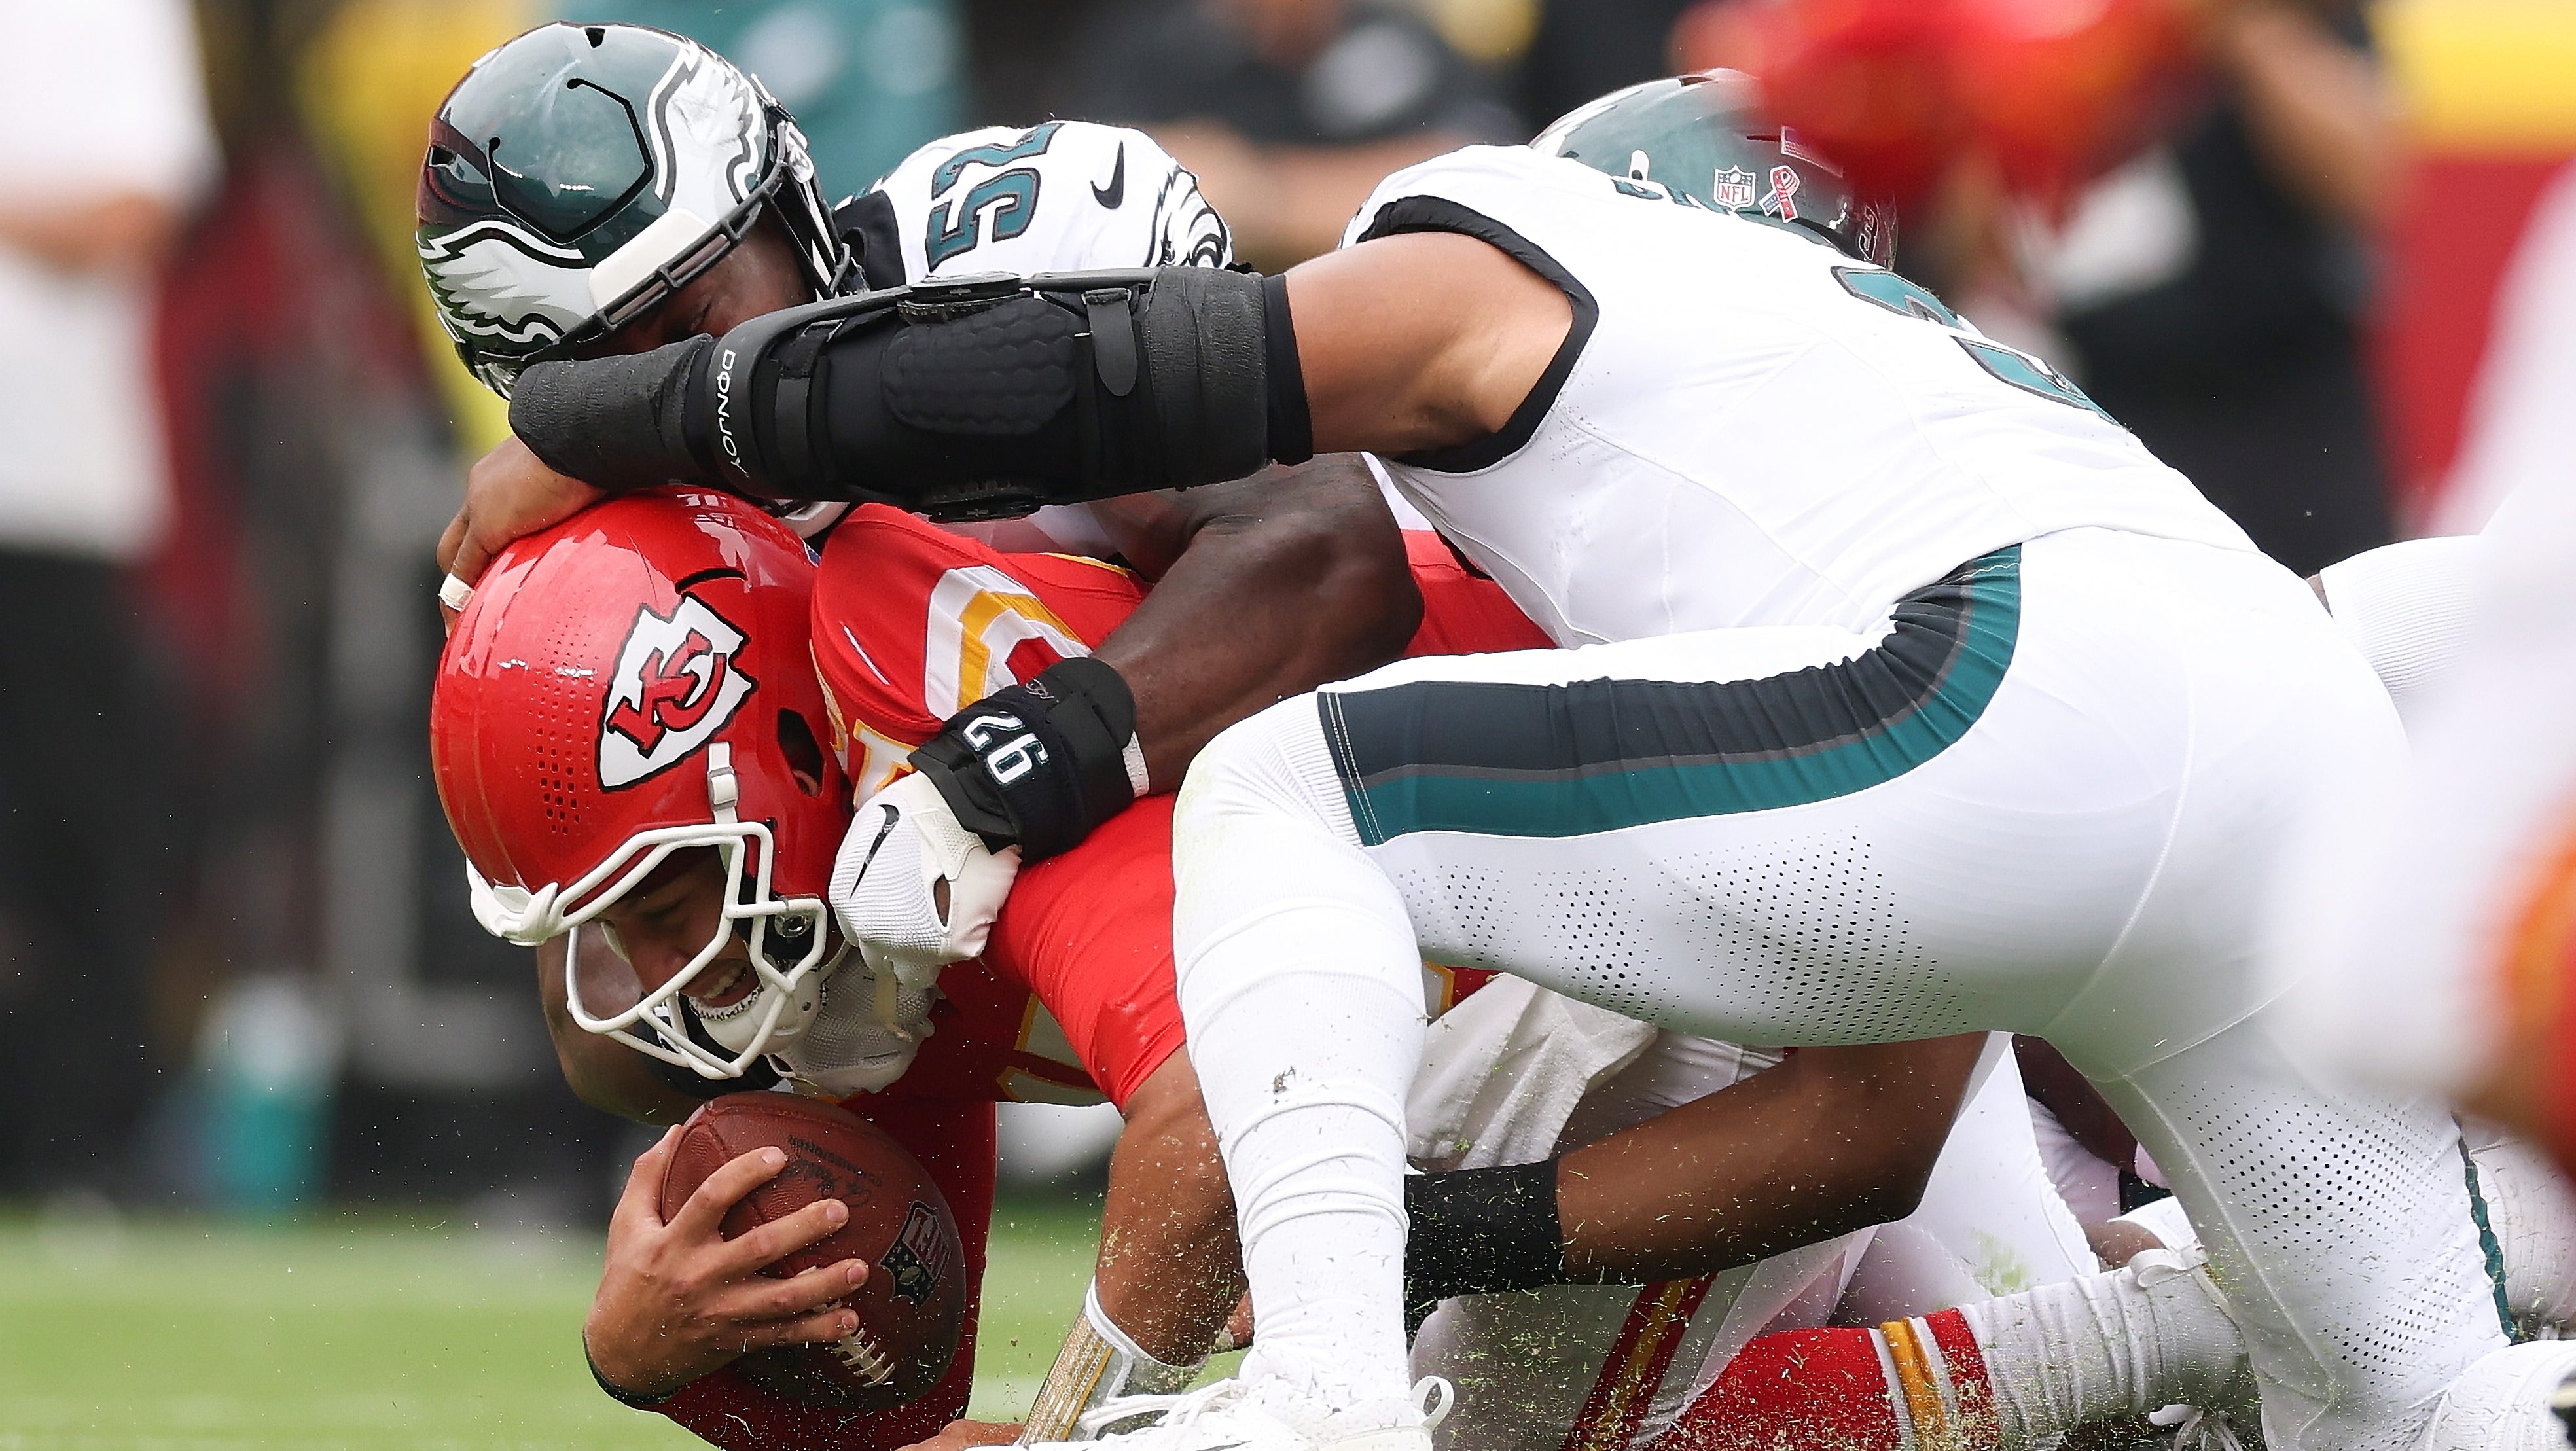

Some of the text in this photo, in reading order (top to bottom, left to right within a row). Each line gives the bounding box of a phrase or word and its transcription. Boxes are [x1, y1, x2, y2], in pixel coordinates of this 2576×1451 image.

[925, 123, 1065, 271] 52
[1721, 185, 1749, 202] NFL
[717, 349, 749, 478] DONJOY
[605, 627, 728, 759] KC
